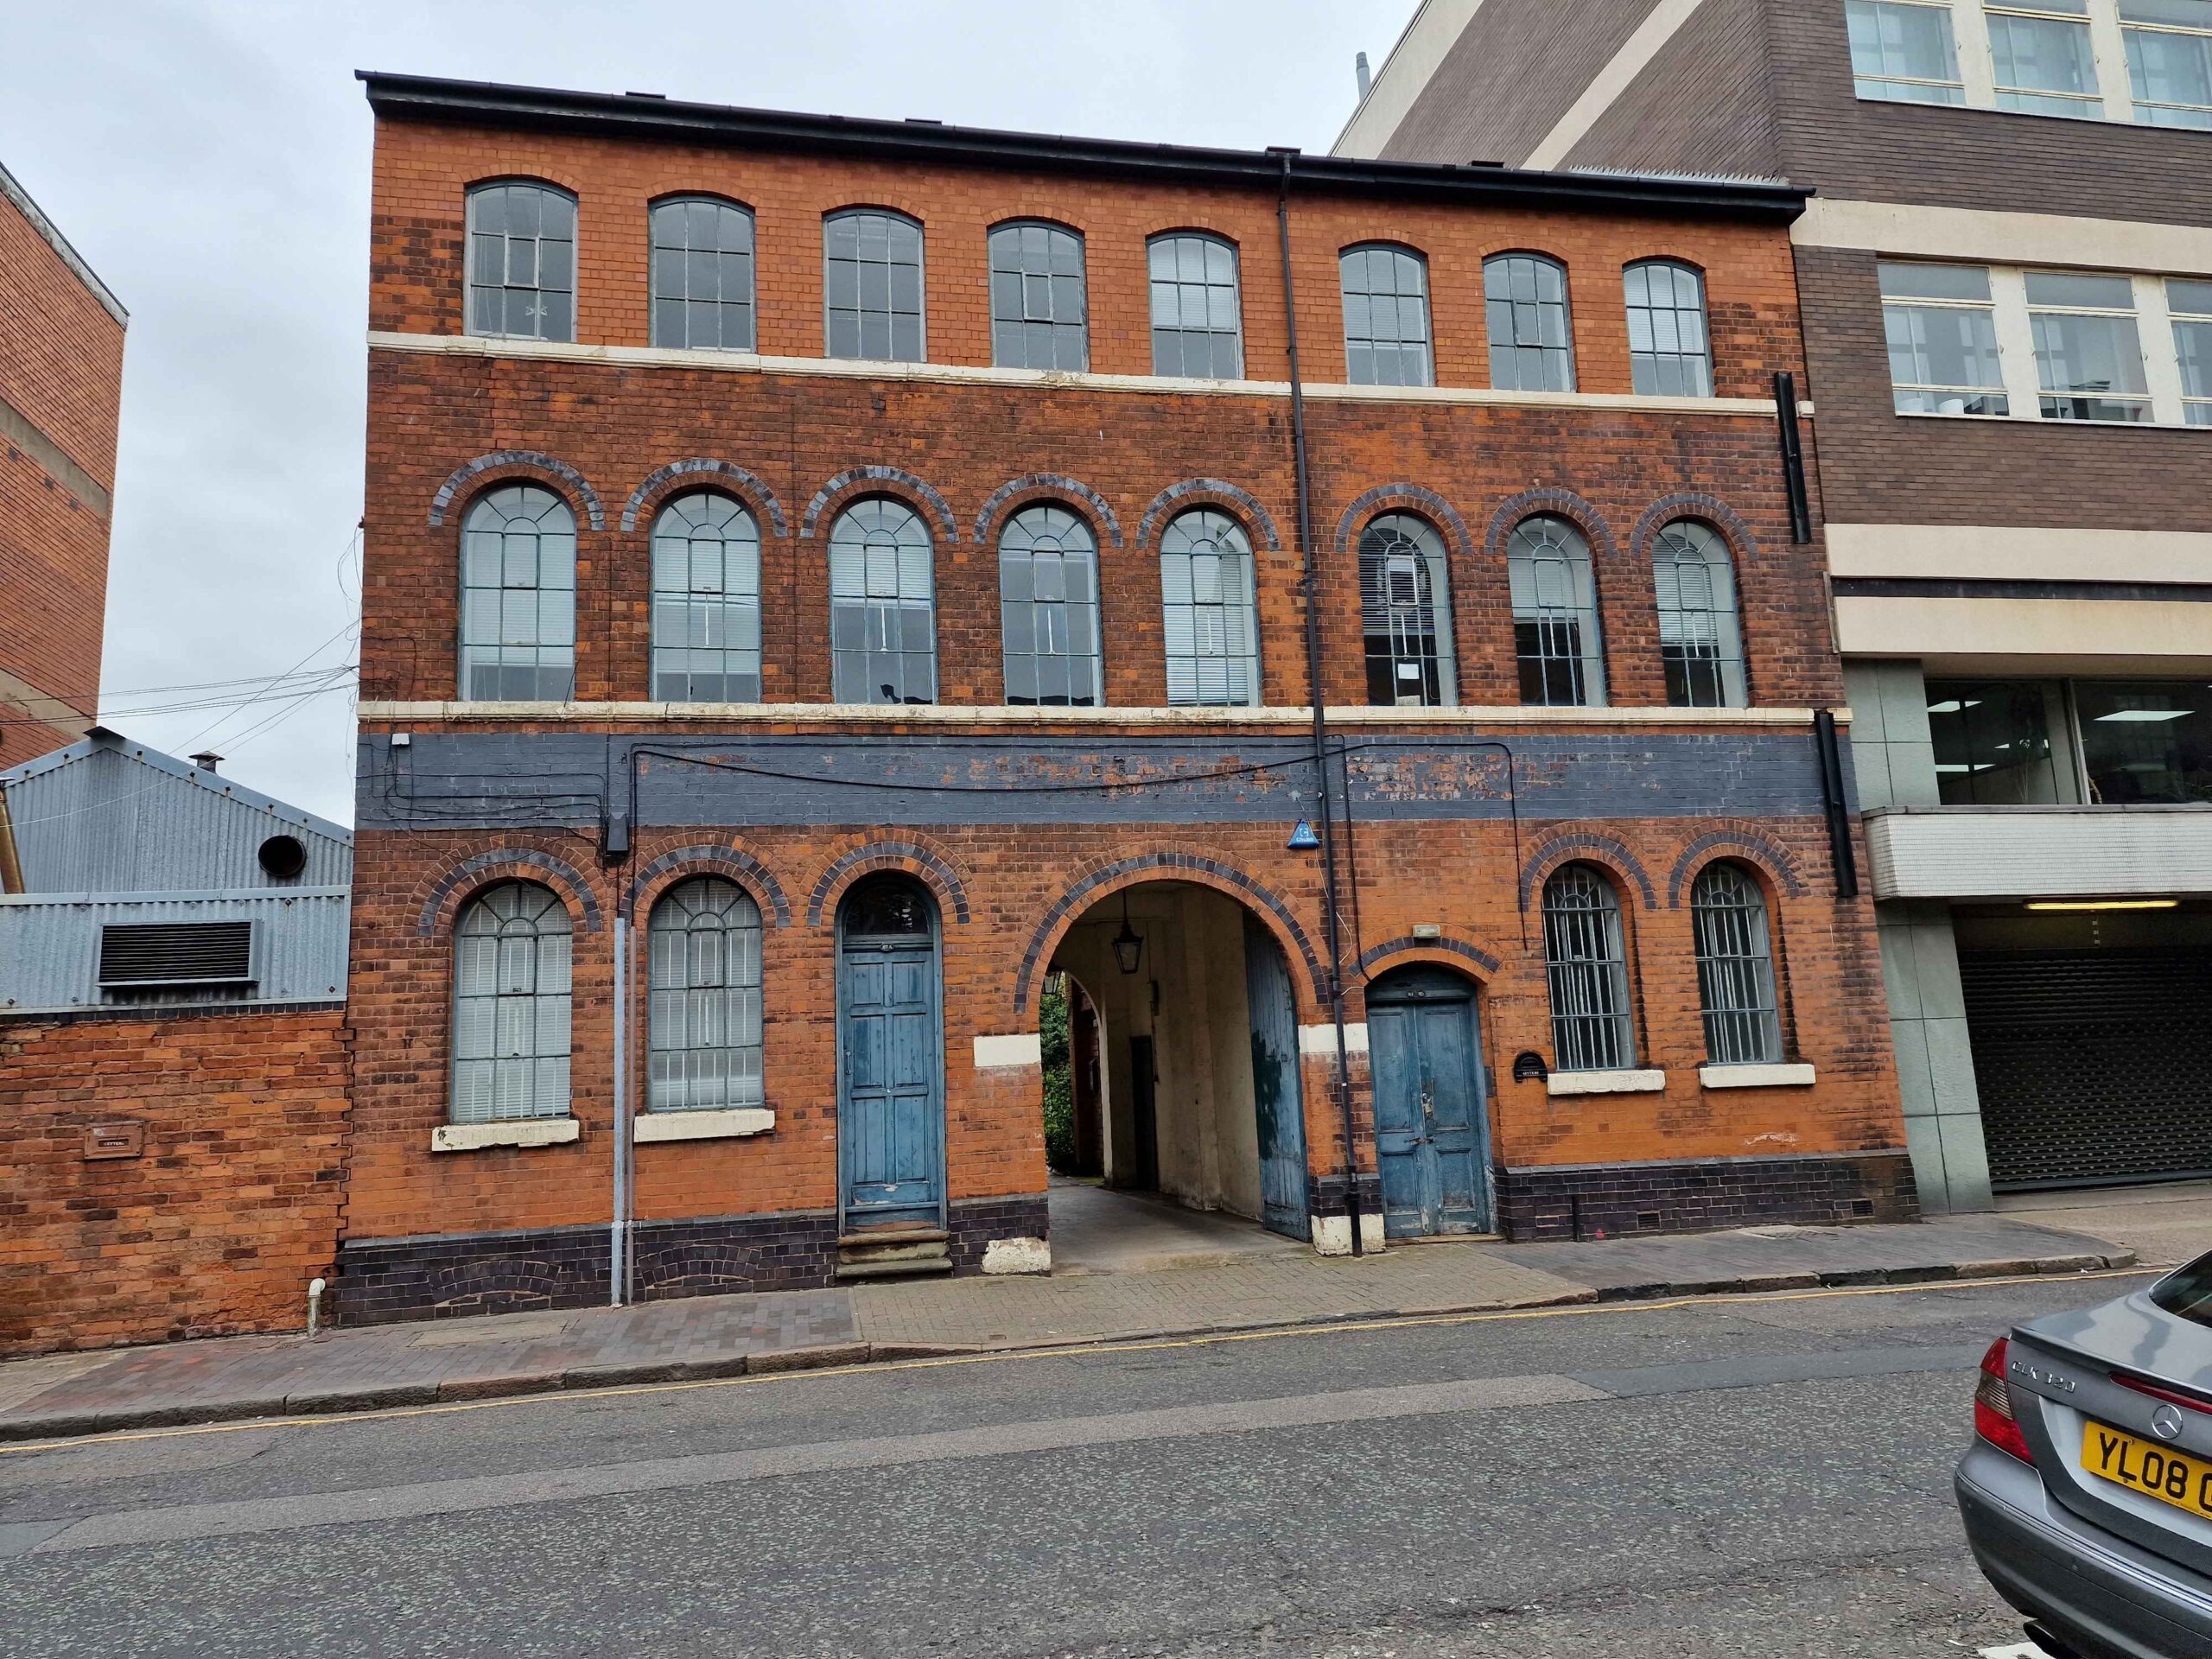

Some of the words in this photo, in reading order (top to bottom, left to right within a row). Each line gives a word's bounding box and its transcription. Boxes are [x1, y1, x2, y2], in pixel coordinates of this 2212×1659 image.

[2012, 1361, 2039, 1380] CLK
[2044, 1372, 2075, 1393] 320
[2099, 1432, 2189, 1500] YL08
